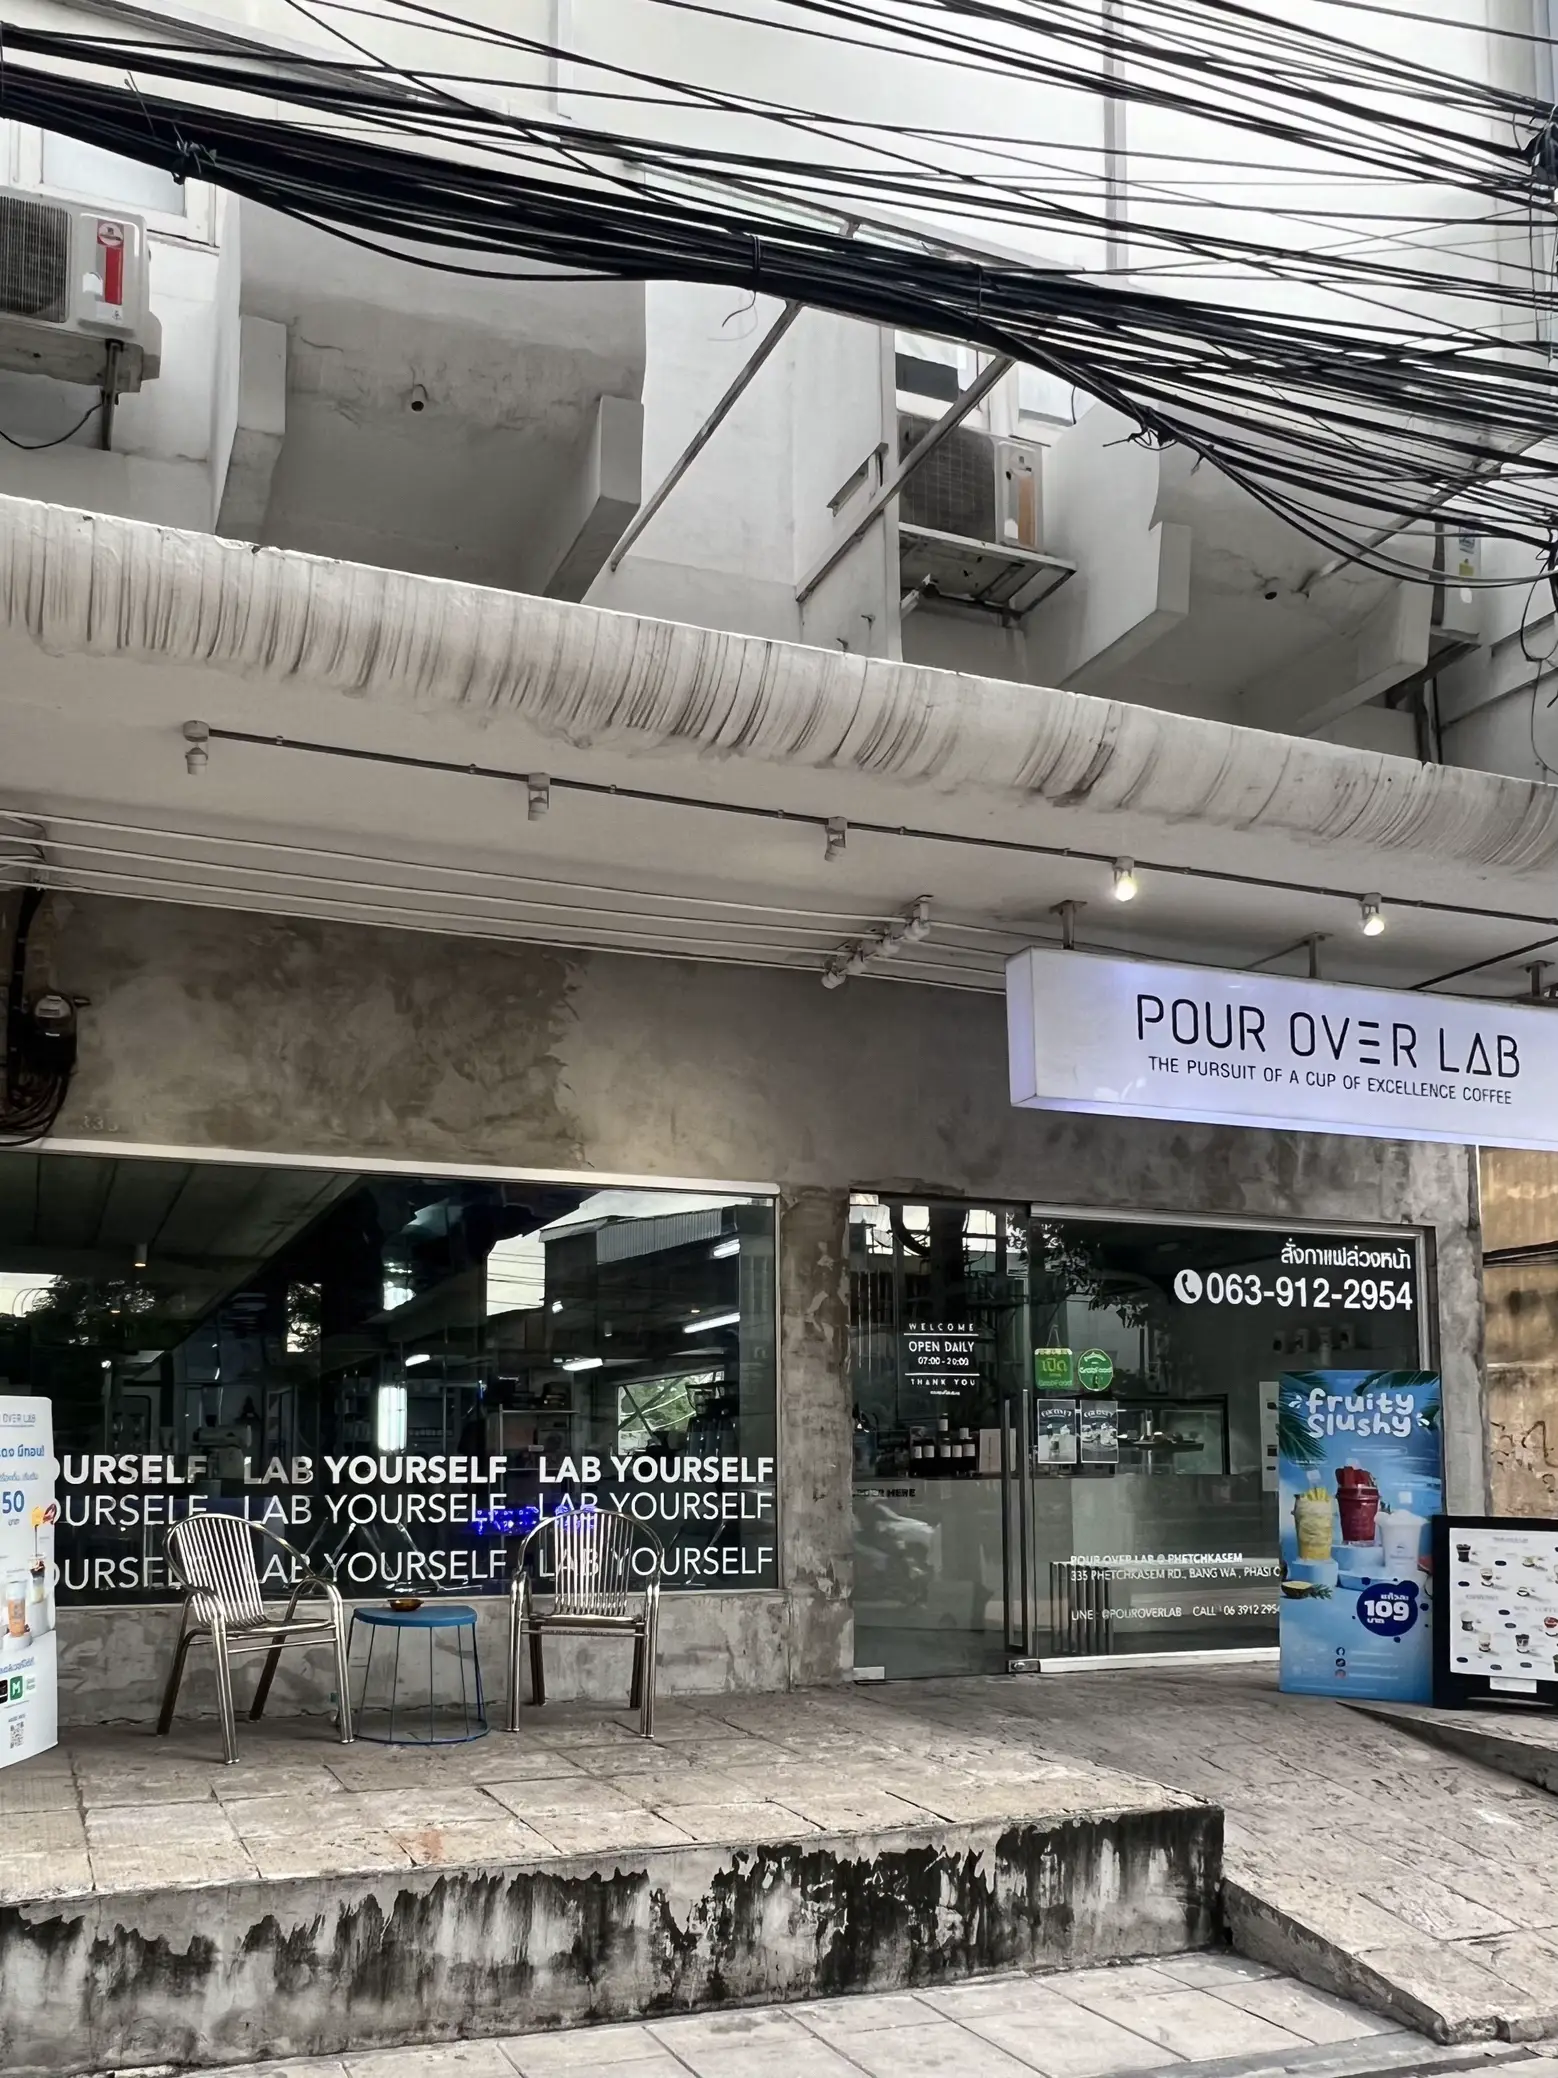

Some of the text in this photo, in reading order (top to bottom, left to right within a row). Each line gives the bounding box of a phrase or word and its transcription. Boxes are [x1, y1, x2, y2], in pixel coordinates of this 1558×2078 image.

[1137, 994, 1520, 1078] POUR OVER LAB
[1148, 1055, 1512, 1104] THE PURSUIT OF A CUP OF EXCELLENCE COFFEE
[1280, 1238, 1412, 1270] สั่งกาแฟล่วงหน้า
[1206, 1272, 1413, 1311] 063-912-2954
[908, 1323, 974, 1332] WELCOME
[908, 1340, 975, 1353] OPEN DAILY
[918, 1356, 941, 1365] 07:00
[911, 1378, 976, 1386] THANK YOU
[1306, 1387, 1414, 1416] fruity
[244, 1456, 314, 1485] LAB
[323, 1455, 508, 1485] YOURSELF
[539, 1456, 602, 1483] LAB
[610, 1455, 774, 1483] YOURSELF
[244, 1494, 312, 1525] LAB
[324, 1493, 507, 1524] YOURSELF
[539, 1492, 598, 1520] LAB
[609, 1491, 773, 1520] YOURSELF
[323, 1550, 507, 1582] YOURSELF
[610, 1547, 774, 1576] YOURSELF
[1070, 1555, 1100, 1567] POUR
[1103, 1554, 1132, 1566] OVER
[1135, 1554, 1155, 1565] LAB
[1168, 1552, 1243, 1565] PHETCHKASEM
[1070, 1569, 1088, 1581] 335
[1091, 1568, 1165, 1580] PHETCHKASEM
[1189, 1567, 1218, 1579] BANG
[1244, 1565, 1271, 1577] PHASI
[1223, 1605, 1235, 1616] 06
[1237, 1604, 1259, 1616] 3912
[1364, 1599, 1410, 1622] 109
